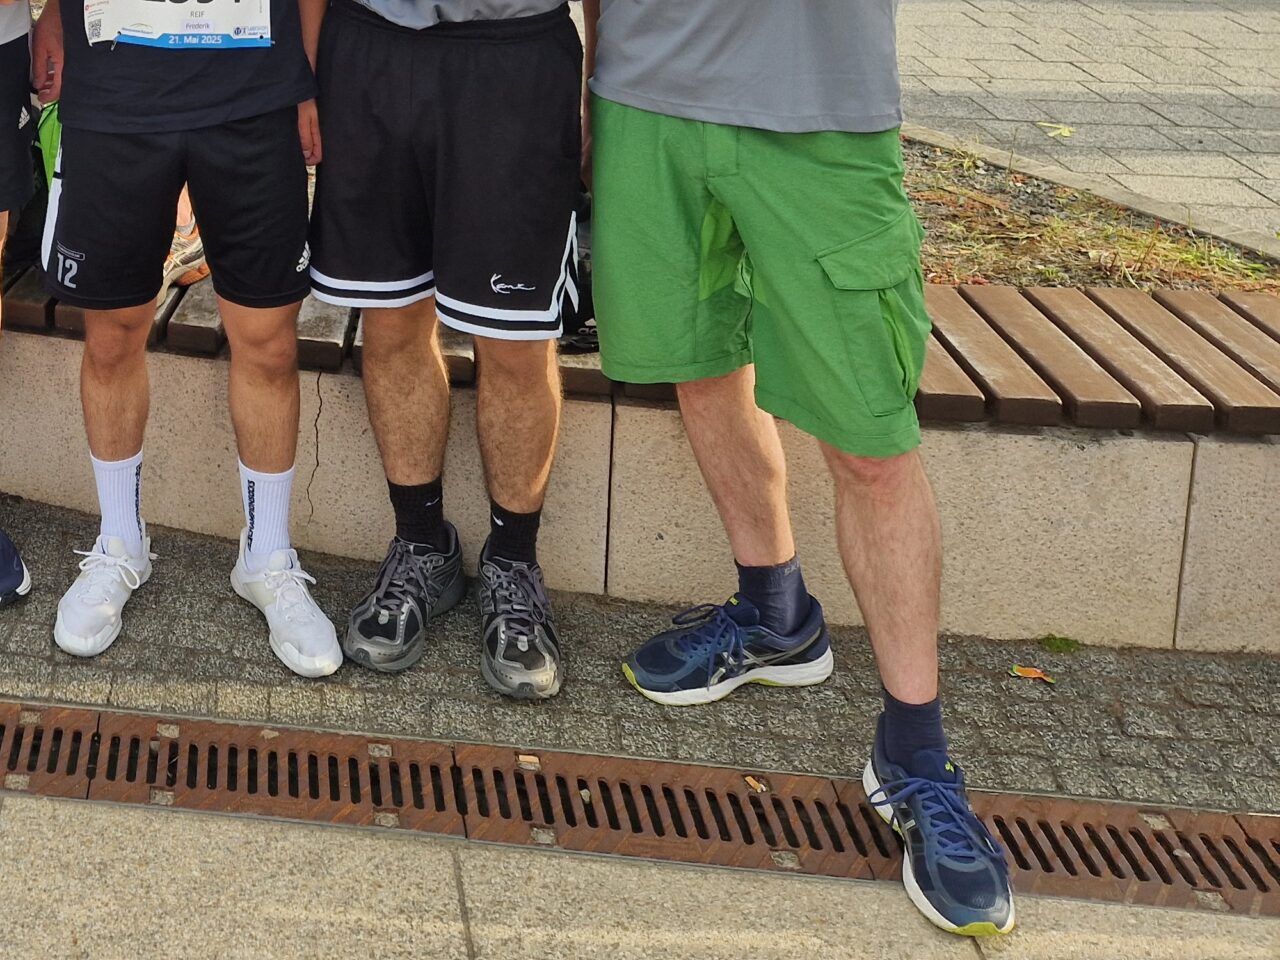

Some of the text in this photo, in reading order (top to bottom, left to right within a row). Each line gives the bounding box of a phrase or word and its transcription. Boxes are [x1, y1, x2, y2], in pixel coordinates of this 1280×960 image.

[190, 10, 205, 18] REIF
[185, 22, 210, 30] Frederik
[169, 35, 223, 44] 21. Mai 2025
[57, 252, 78, 289] 12
